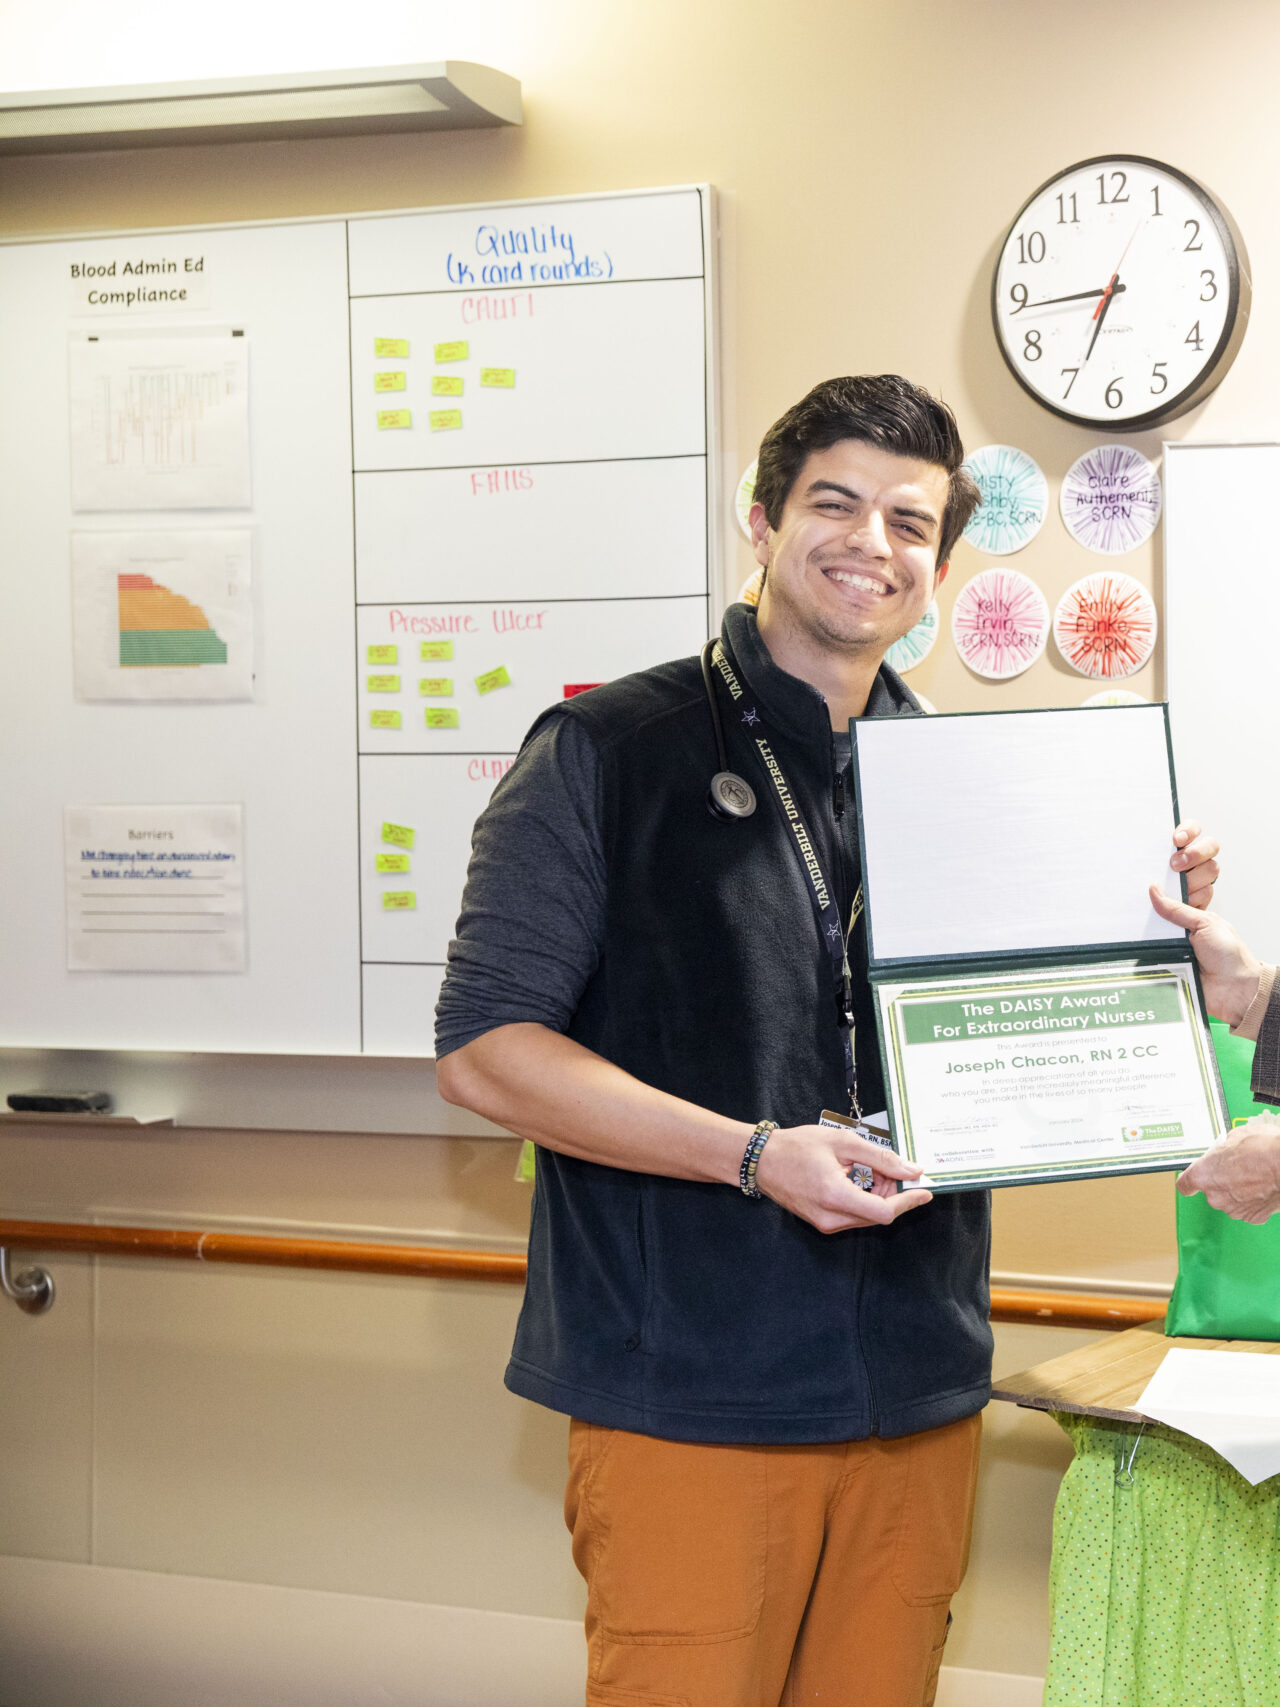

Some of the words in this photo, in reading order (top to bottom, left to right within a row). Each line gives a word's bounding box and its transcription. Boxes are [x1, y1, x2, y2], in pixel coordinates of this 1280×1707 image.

[1096, 171, 1130, 205] 12
[1150, 185, 1163, 216] 1
[1056, 192, 1080, 224] 11
[475, 225, 575, 264] Quality
[1017, 231, 1046, 264] 10
[1183, 219, 1203, 252] 2
[70, 260, 116, 278] Blood
[122, 258, 177, 276] Admin
[184, 256, 204, 272] Ed
[482, 261, 522, 284] card
[88, 286, 187, 307] Compliance
[1009, 283, 1029, 315] 9
[1200, 269, 1217, 302] 3
[1023, 330, 1043, 361] 8
[1184, 320, 1204, 351] 4
[1061, 368, 1080, 400] 7
[1105, 377, 1124, 409] 6
[1150, 363, 1168, 395] 5
[1088, 472, 1130, 489] Claire
[1091, 505, 1132, 522] SCRN
[389, 609, 479, 634] Pressure
[1082, 636, 1127, 654] SCRN
[756, 738, 799, 820] UNIVERSITY
[128, 829, 174, 841] Barriers
[792, 821, 831, 910] VANDERBILT
[961, 1003, 995, 1018] The
[1000, 997, 1054, 1014] DAISY
[933, 1024, 961, 1039] For
[966, 1015, 1090, 1036] Extraordinary
[1094, 1008, 1156, 1026] Nurses
[945, 1058, 1006, 1074] Joseph
[1011, 1053, 1085, 1069] Chacon,
[1090, 1048, 1113, 1062] RN
[1118, 1046, 1128, 1059] 2
[1132, 1044, 1159, 1058] CC
[1014, 1041, 1043, 1049] Award
